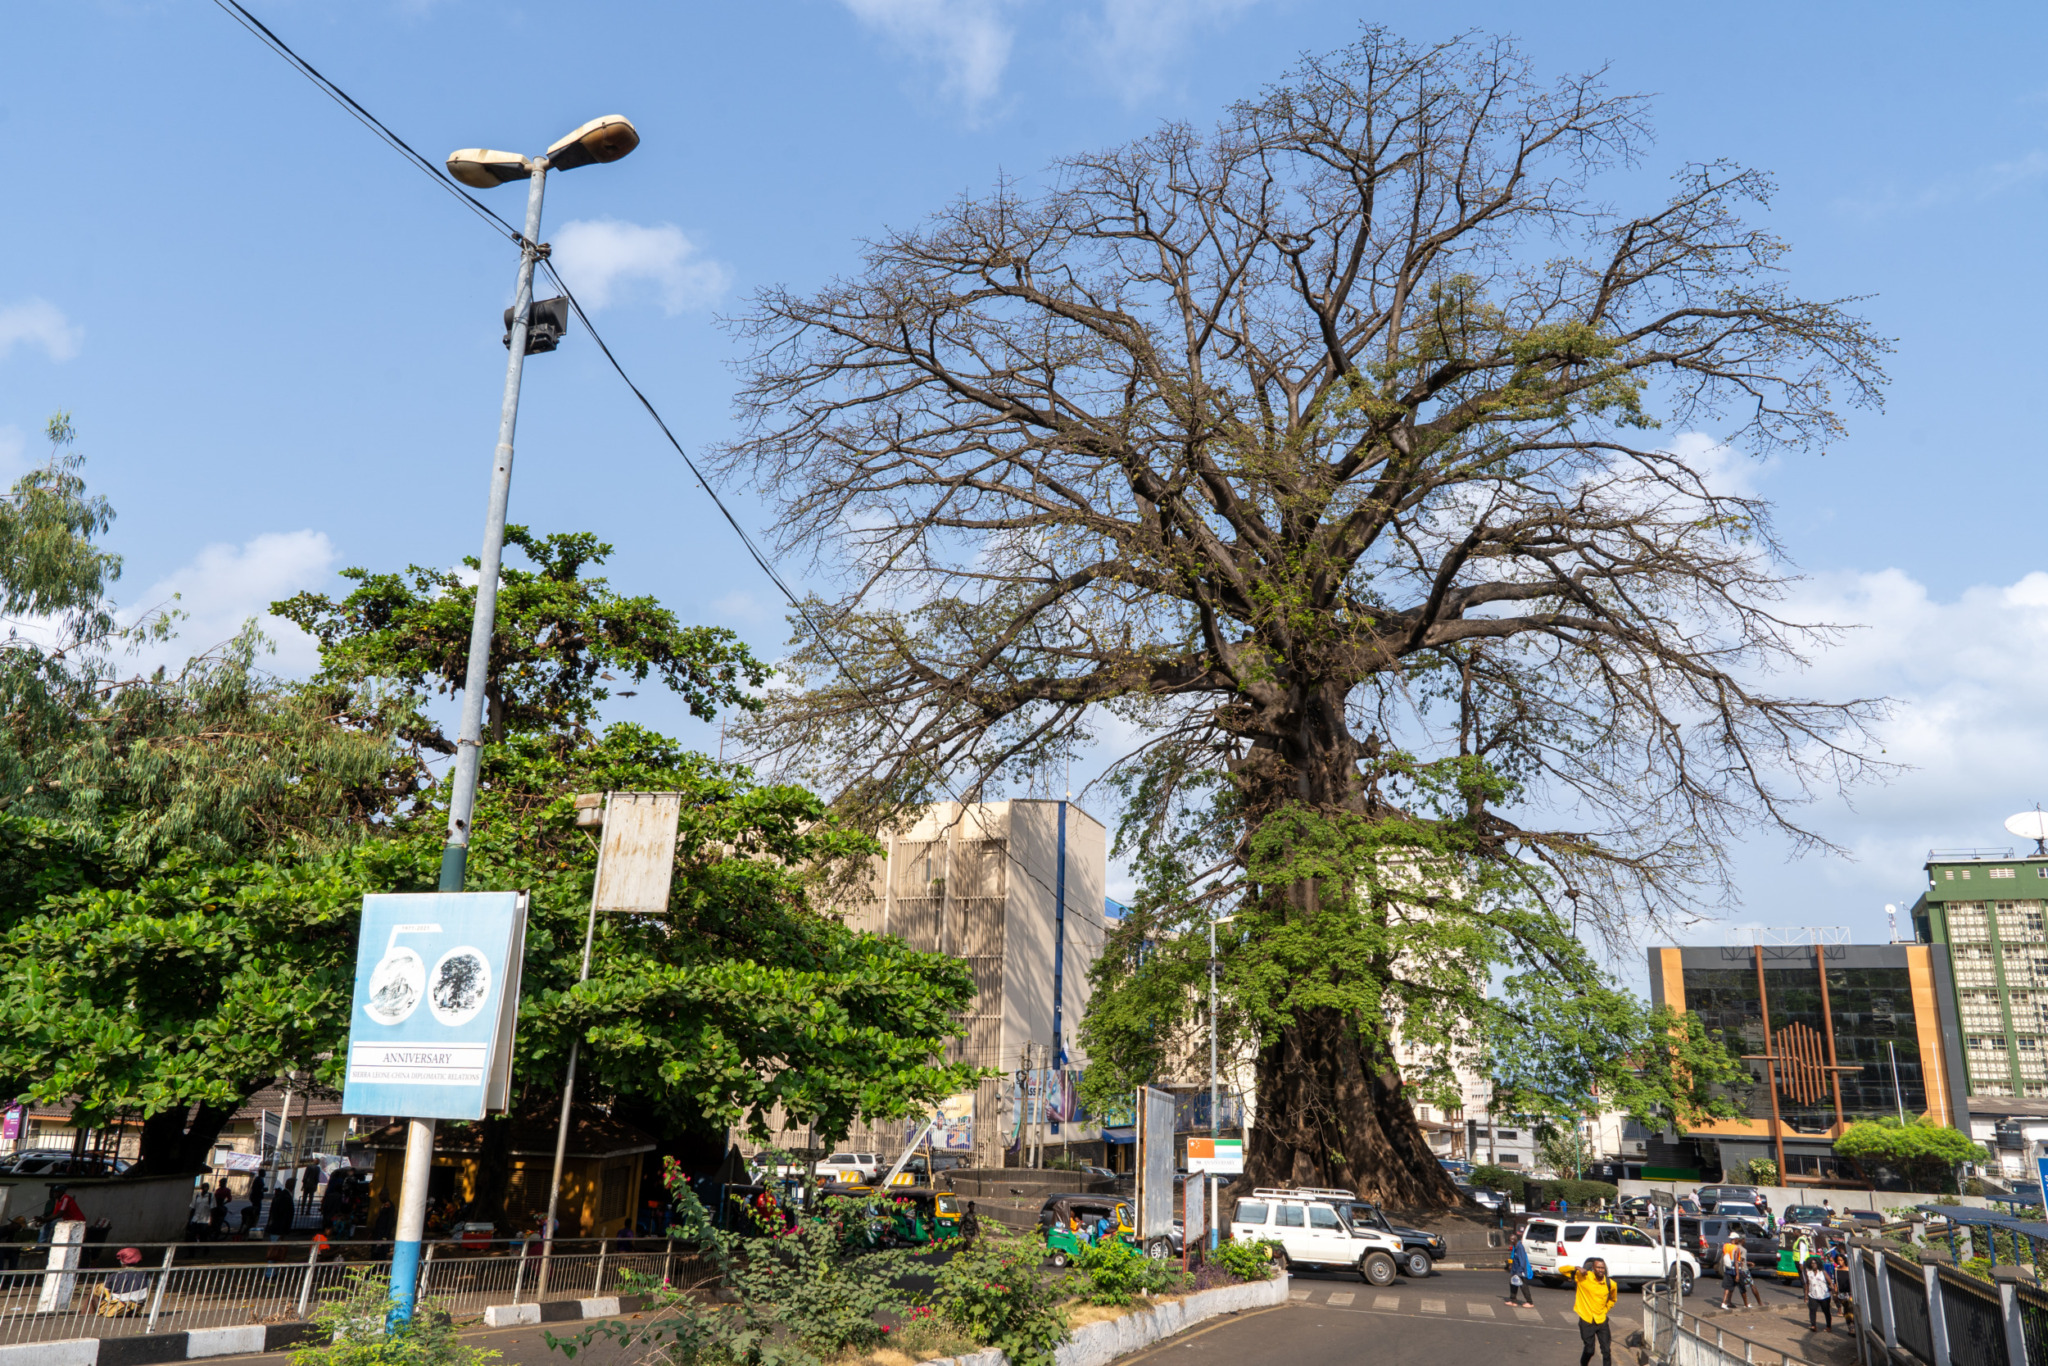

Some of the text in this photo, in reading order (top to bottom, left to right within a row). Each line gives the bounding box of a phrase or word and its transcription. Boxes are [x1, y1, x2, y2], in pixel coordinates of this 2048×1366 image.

[363, 923, 492, 1027] 50
[383, 1053, 452, 1064] ANNIVERSARY
[352, 1071, 371, 1079] SIERRA
[411, 1072, 447, 1080] DIPLOMATIC
[448, 1073, 480, 1081] RELATIONS
